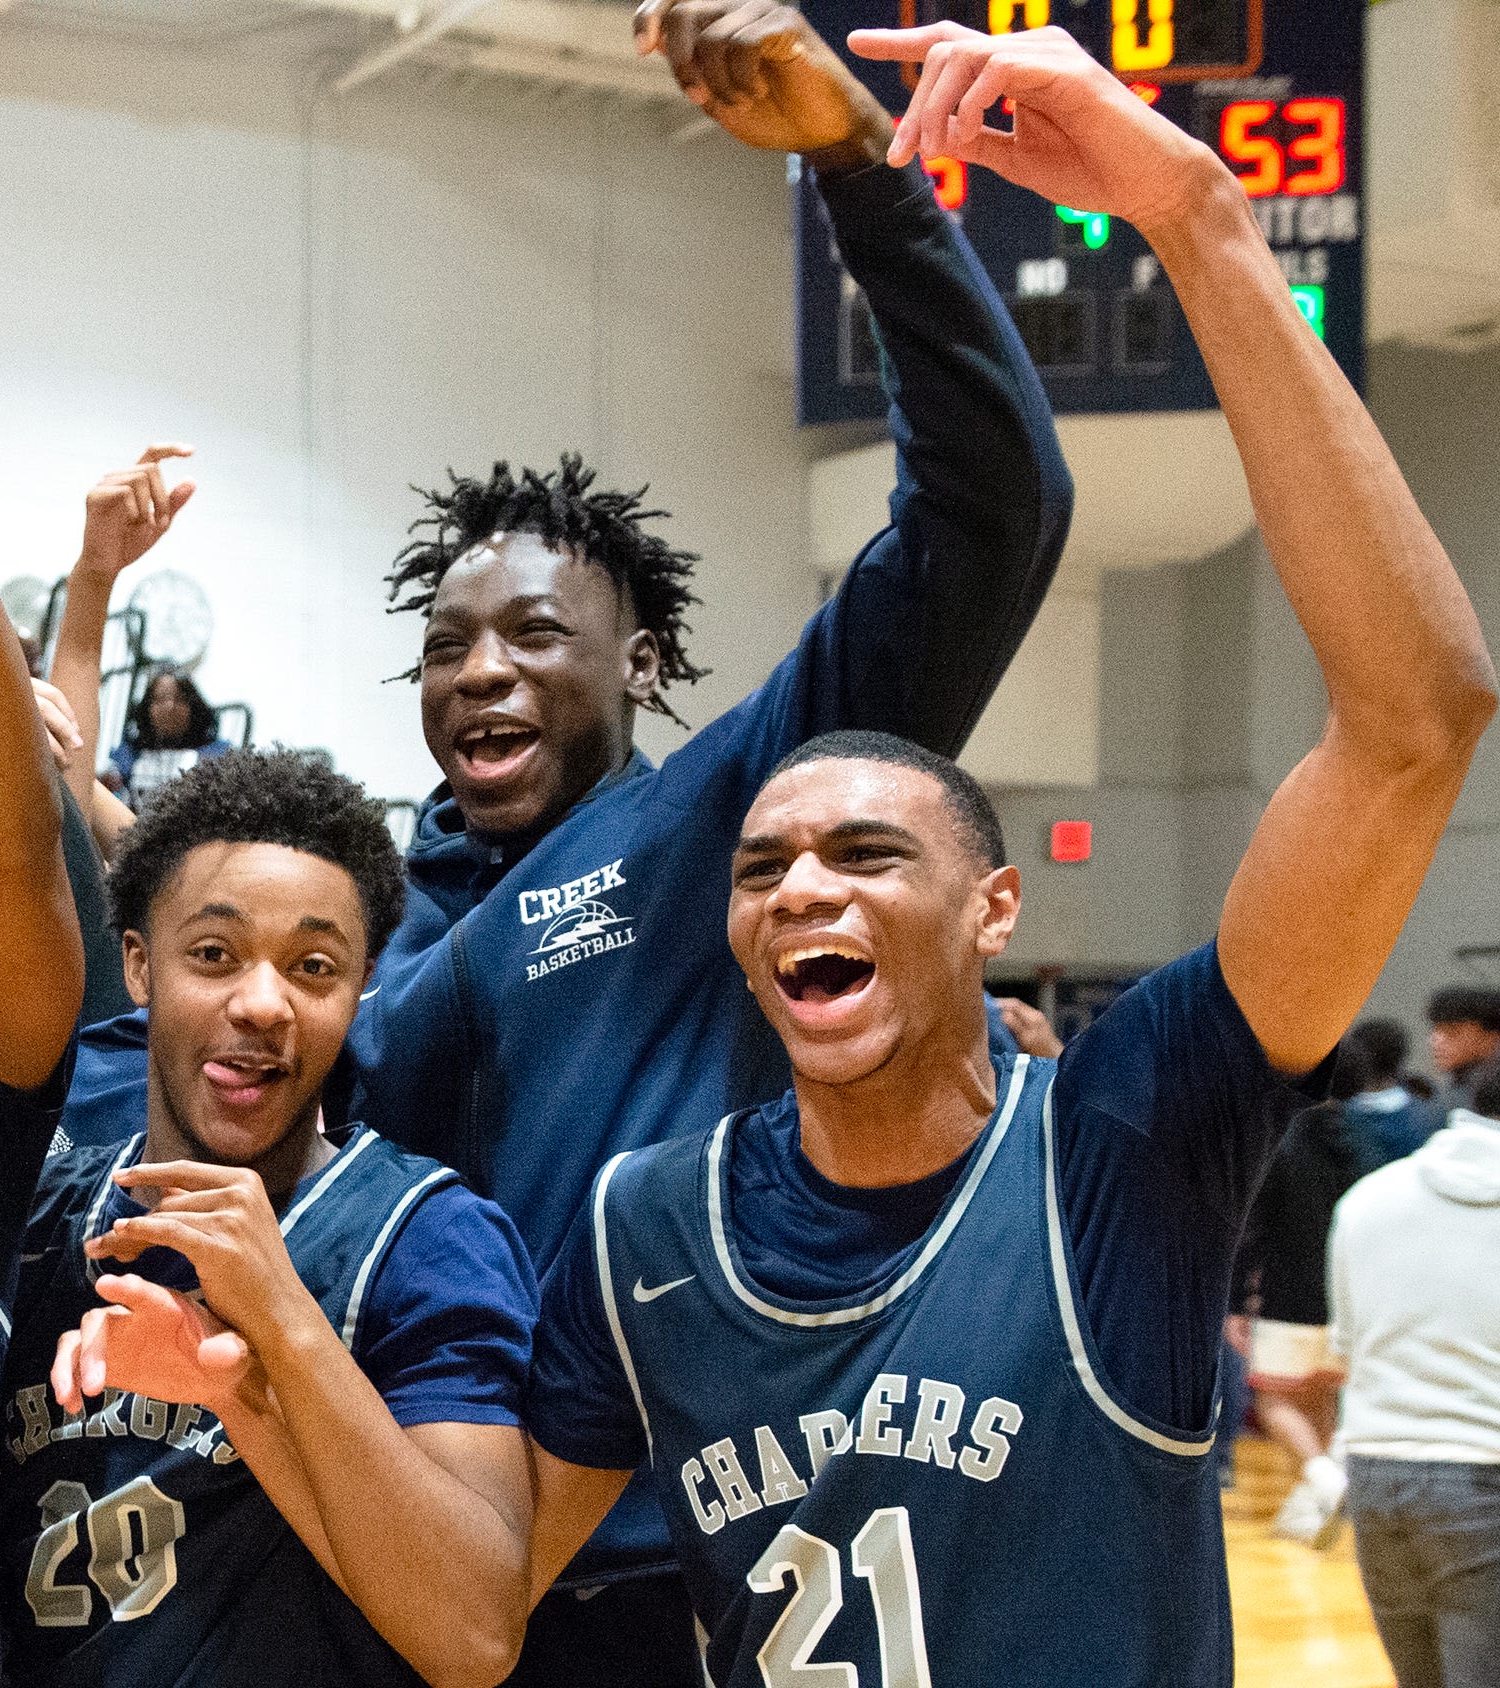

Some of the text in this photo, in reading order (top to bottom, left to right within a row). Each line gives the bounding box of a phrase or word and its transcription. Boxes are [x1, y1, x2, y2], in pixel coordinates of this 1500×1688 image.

[1220, 97, 1345, 198] 53
[518, 857, 627, 926] CREEK
[525, 927, 638, 983] BASKETBALL
[681, 1372, 1024, 1535] CHARERS
[24, 1474, 186, 1627] 20
[746, 1506, 933, 1688] 21
